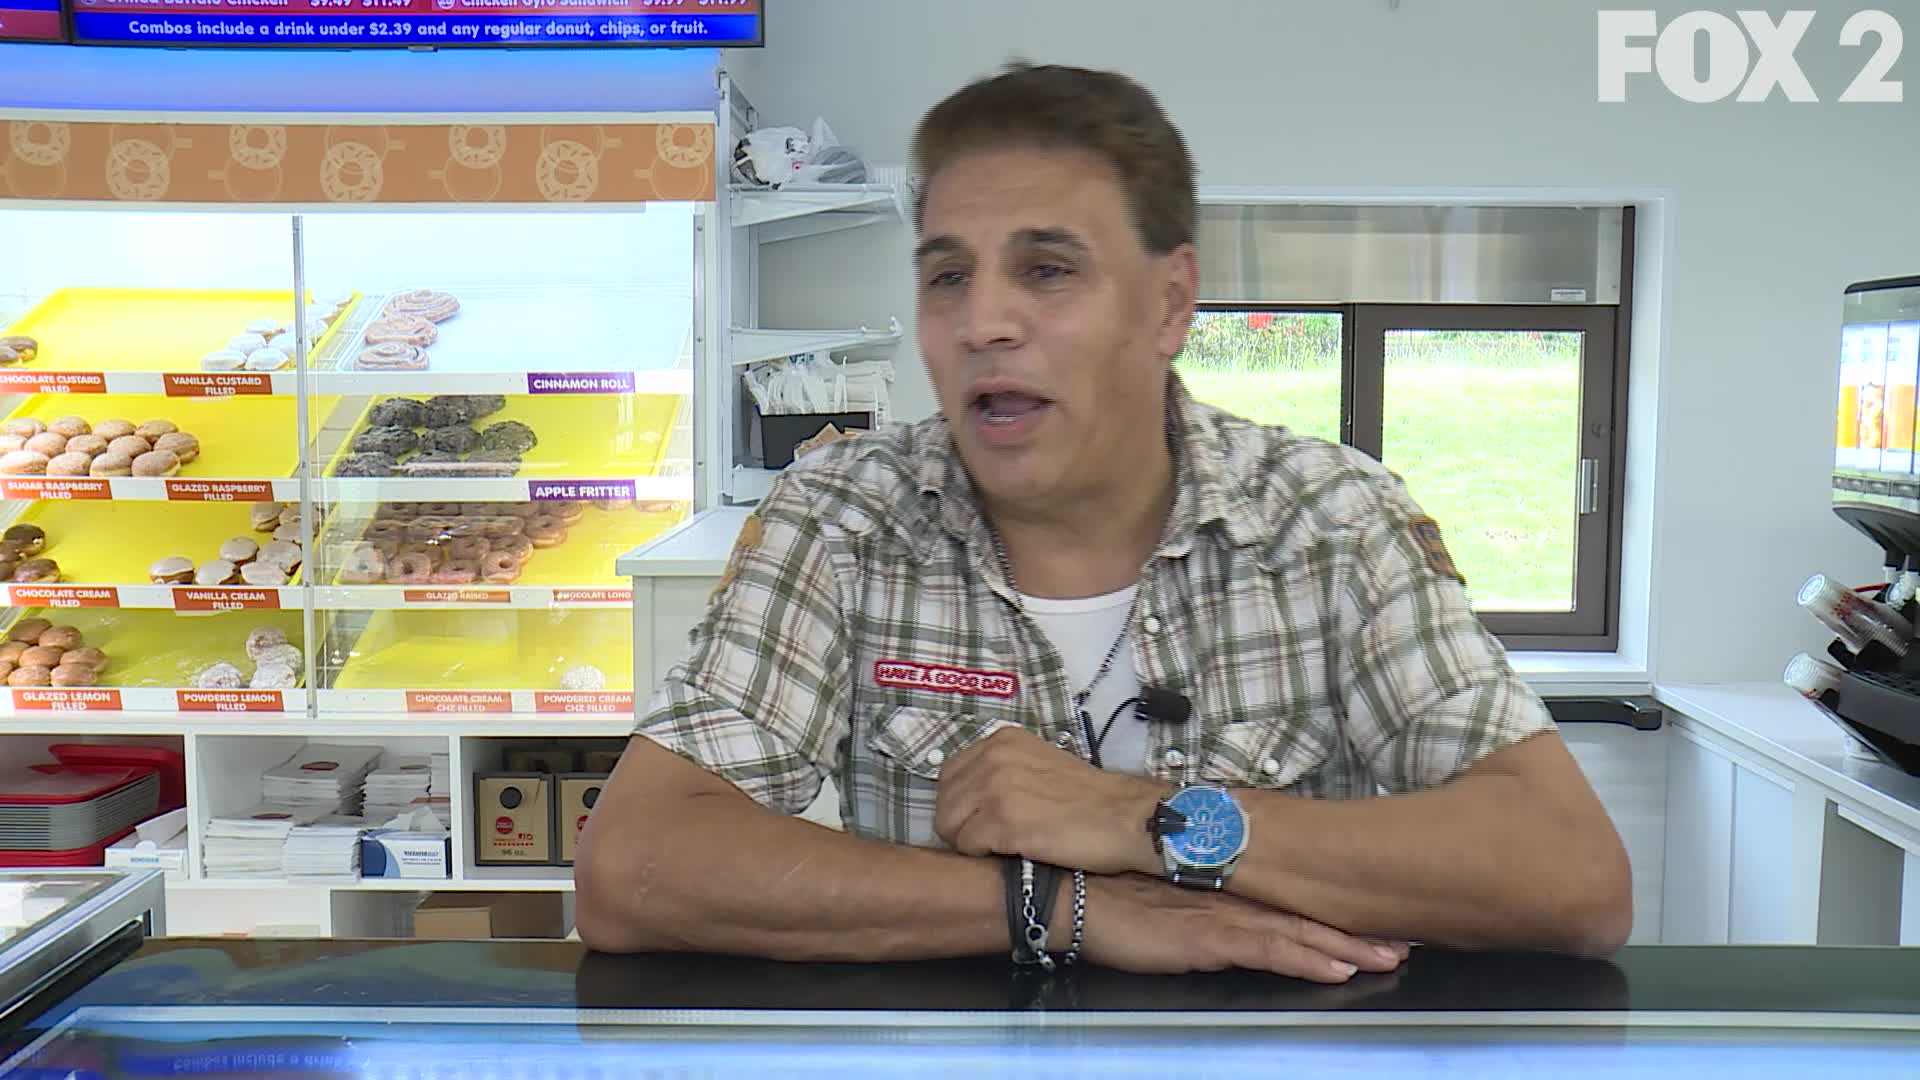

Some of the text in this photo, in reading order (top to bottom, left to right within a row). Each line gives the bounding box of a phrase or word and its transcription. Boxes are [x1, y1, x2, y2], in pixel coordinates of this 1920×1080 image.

[128, 20, 708, 39] Combos include a drink under $2.39 and any regular donut, chips, or fruit.
[56, 376, 101, 385] CUSTARD
[172, 376, 262, 386] VANILLA CUSTARD
[533, 379, 629, 389] CINNAMON ROLL
[40, 385, 71, 393] FILLED
[205, 387, 236, 395] FILLED
[8, 482, 103, 491] SUGAR RASPBERRY
[171, 484, 266, 493] GLAZED RASPBERRY
[39, 491, 72, 500] FILLED
[535, 486, 630, 498] APPLE FRITTER
[203, 493, 234, 501] FILLED
[15, 589, 111, 599] CHOCOLATE CREAM
[186, 591, 266, 601] VANILLA CREAM
[50, 599, 81, 608] FILLED
[212, 601, 244, 610] FILLED
[879, 667, 918, 681] HAVE
[935, 672, 978, 687] GOOD
[981, 678, 1010, 692] DAY
[22, 692, 111, 702] GLAZED LEMON
[183, 693, 276, 703] POWDERED LEMON
[415, 694, 503, 703] CHOCOLATE CREAM
[543, 694, 632, 703] POWDERED CREAM
[51, 702, 87, 711] FILLED
[216, 703, 247, 711] FILLED
[458, 704, 486, 712] FILLED
[587, 704, 615, 712] FILLED
